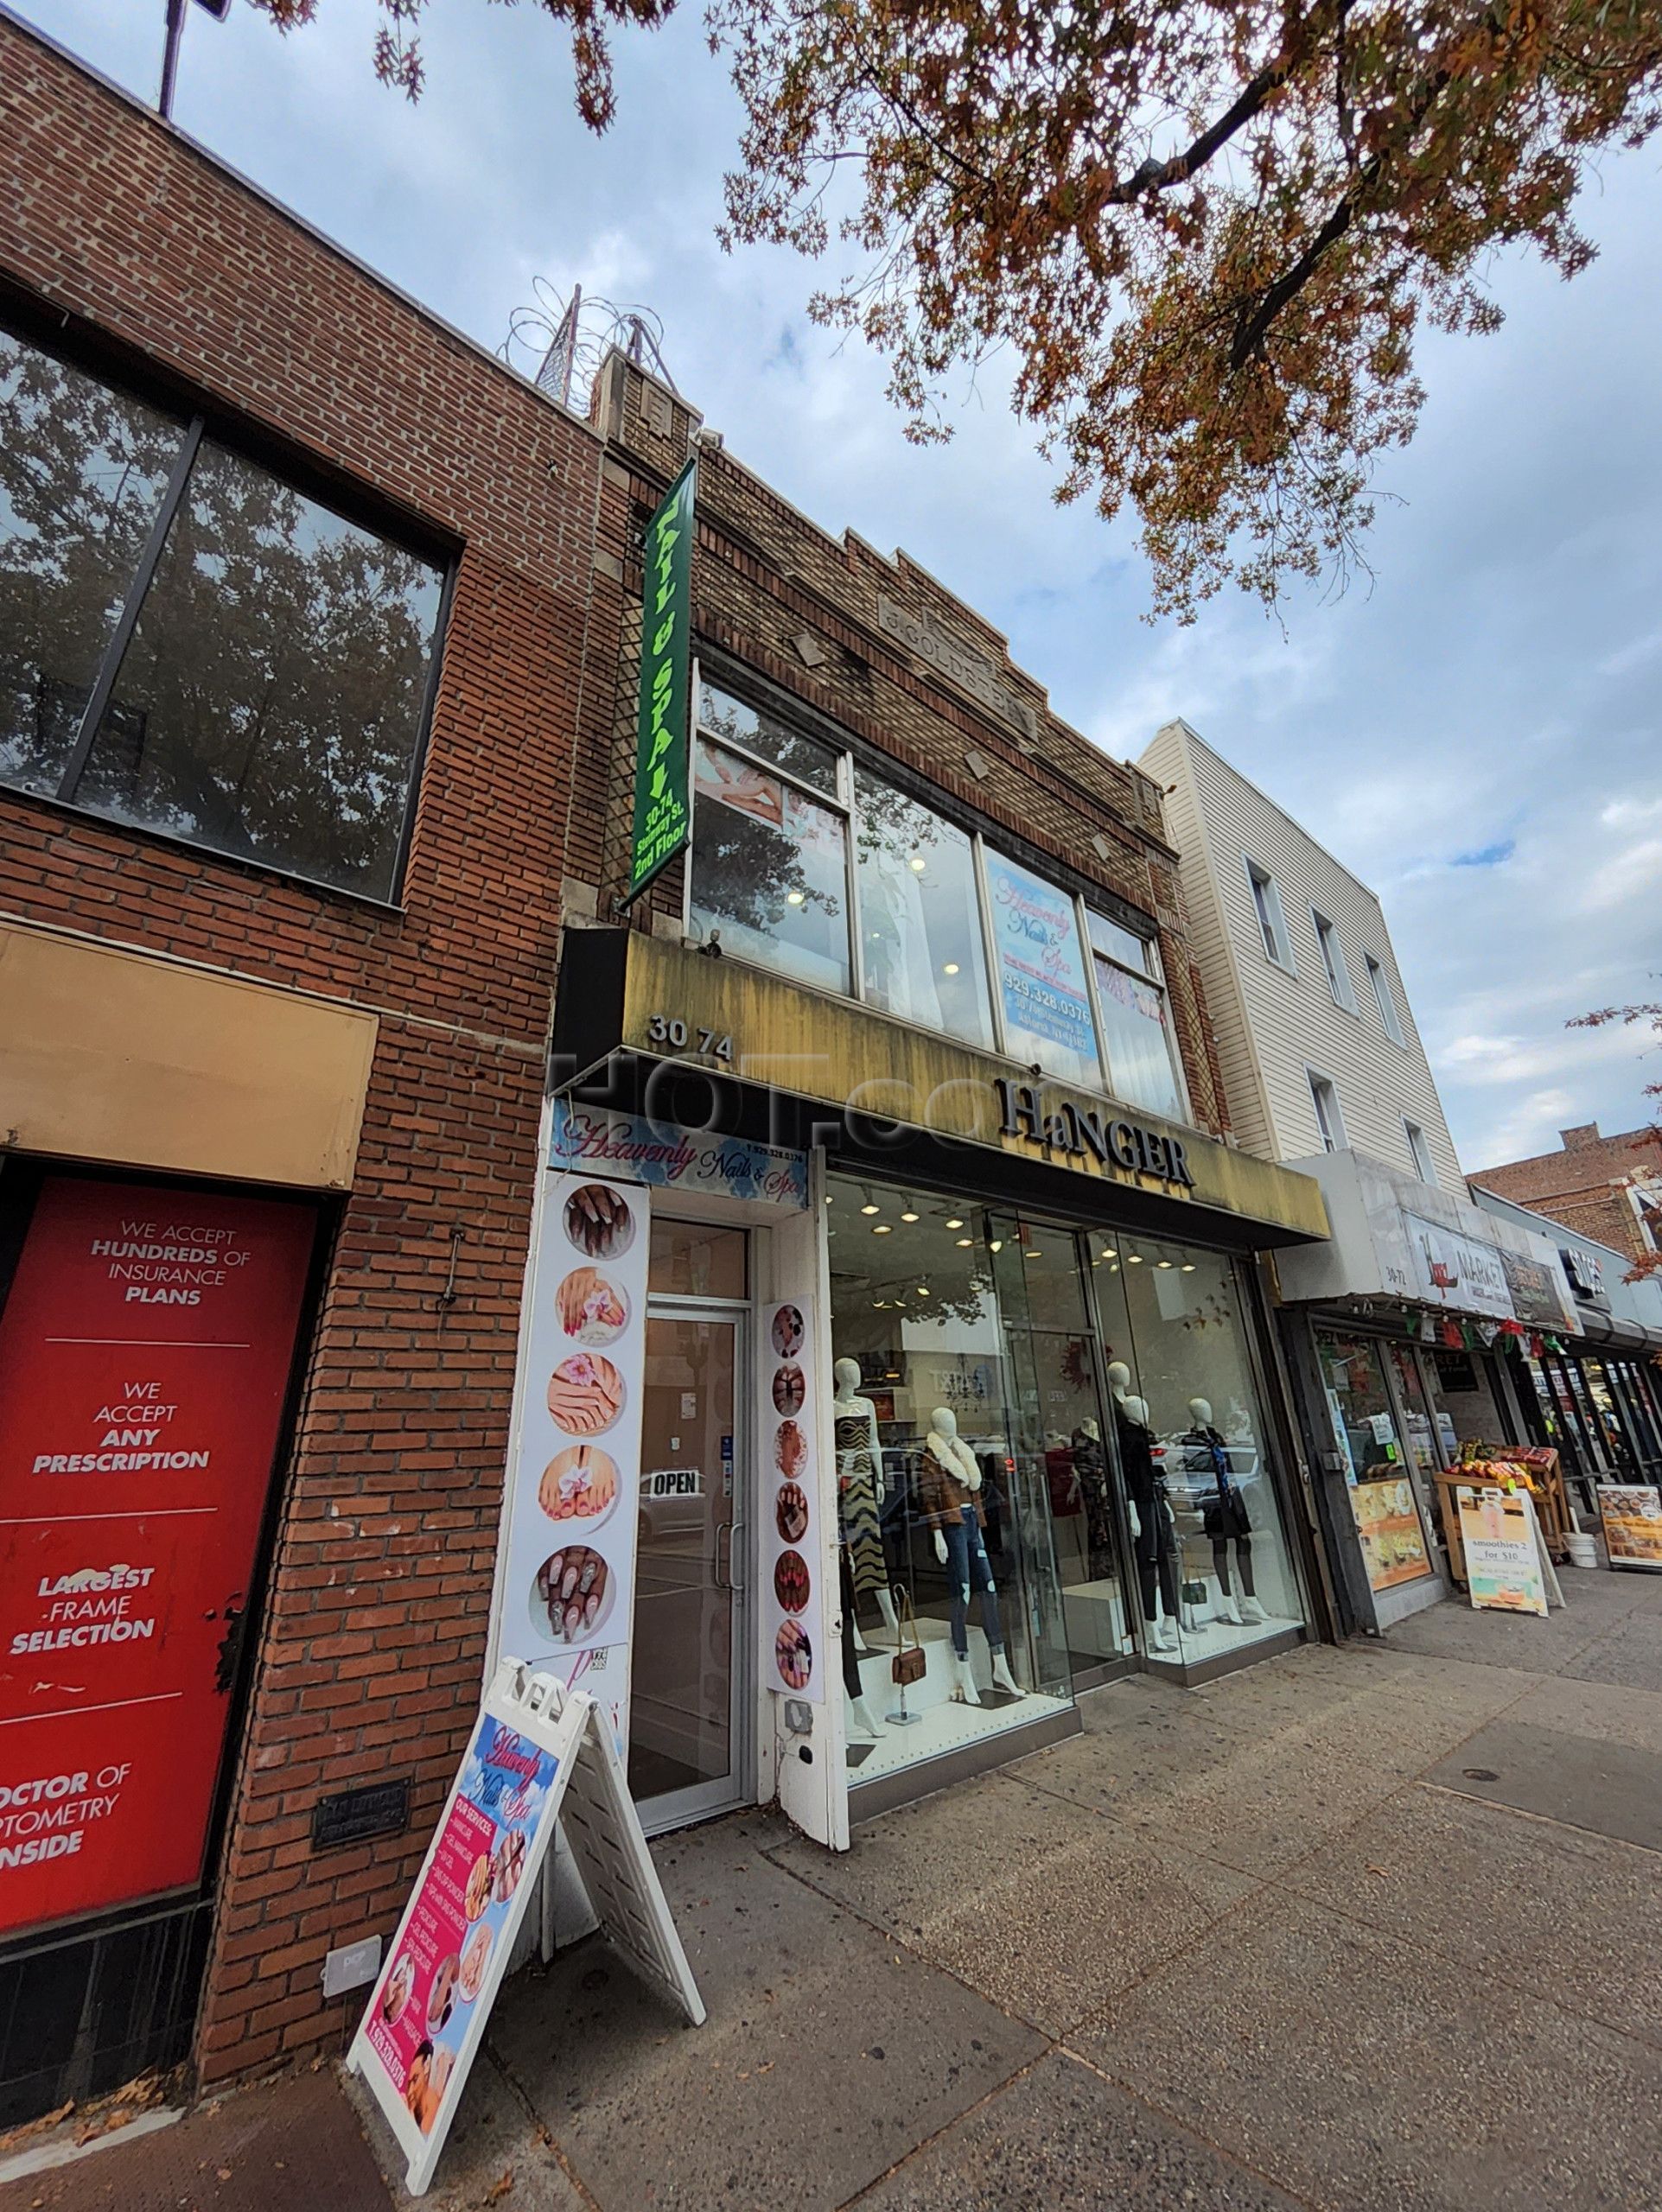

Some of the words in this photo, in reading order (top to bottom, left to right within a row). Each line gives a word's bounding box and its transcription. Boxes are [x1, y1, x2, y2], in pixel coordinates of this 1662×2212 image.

[654, 489, 681, 614] NAIL
[647, 658, 673, 771] SPA
[646, 788, 672, 831] 30-74
[635, 847, 653, 880] 2nd
[656, 821, 686, 858] Floor
[996, 877, 1070, 940] Heavenly
[1008, 907, 1048, 945] Nails
[1041, 946, 1072, 978] Spa
[1003, 972, 1092, 1026] 929.328.0376
[649, 1014, 689, 1048] 30
[698, 1027, 734, 1063] 74
[994, 1078, 1197, 1186] HaNGER
[554, 1114, 698, 1180] Heavenly
[697, 1150, 753, 1179] Nails
[754, 1166, 764, 1181] &
[764, 1168, 800, 1203] Spa
[121, 1220, 157, 1239] WE
[161, 1225, 237, 1245] ACCEPT
[91, 1240, 218, 1265] HUNDREDS
[224, 1251, 252, 1268] OF
[108, 1262, 227, 1286] INSURANCE
[124, 1287, 201, 1306] PLANS
[124, 1382, 162, 1399] WE
[92, 1405, 177, 1423] ACCEPT
[100, 1428, 161, 1447] ANY
[31, 1451, 210, 1474] PRESCRIPTION
[653, 1471, 697, 1496] OPEN
[1472, 1541, 1519, 1549] smoothies
[1485, 1550, 1497, 1559] for
[38, 1565, 155, 1597] LARGEST
[49, 1595, 132, 1623] FRAME
[10, 1618, 155, 1656] SELECTION
[486, 1724, 543, 1793] Heavenly
[97, 1762, 132, 1788] OF
[468, 1768, 505, 1808] Nails
[456, 1798, 468, 1815] OUR
